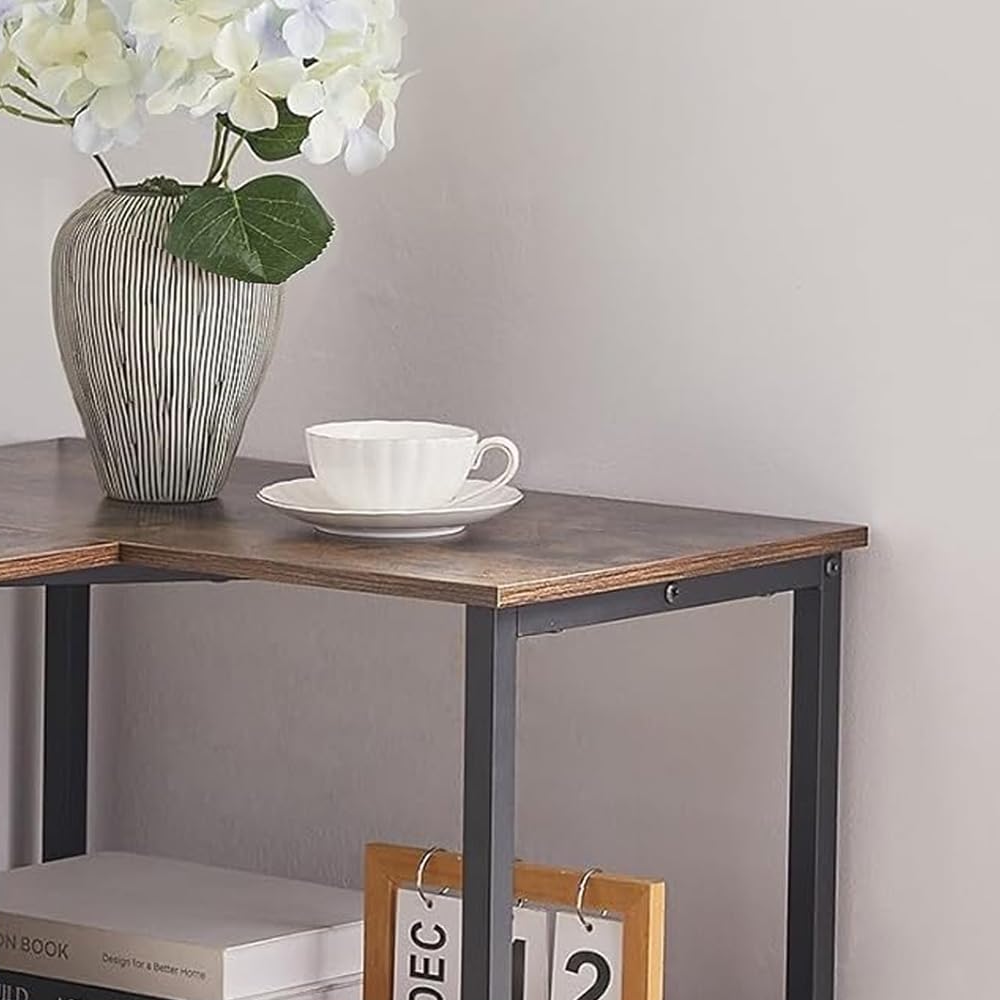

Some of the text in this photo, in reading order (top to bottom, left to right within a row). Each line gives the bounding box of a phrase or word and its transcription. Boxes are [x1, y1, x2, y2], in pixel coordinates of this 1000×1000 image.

[21, 937, 69, 960] BOOK
[102, 952, 131, 969] Design
[132, 958, 145, 969] for
[153, 962, 179, 975] Better
[180, 967, 206, 980] Home
